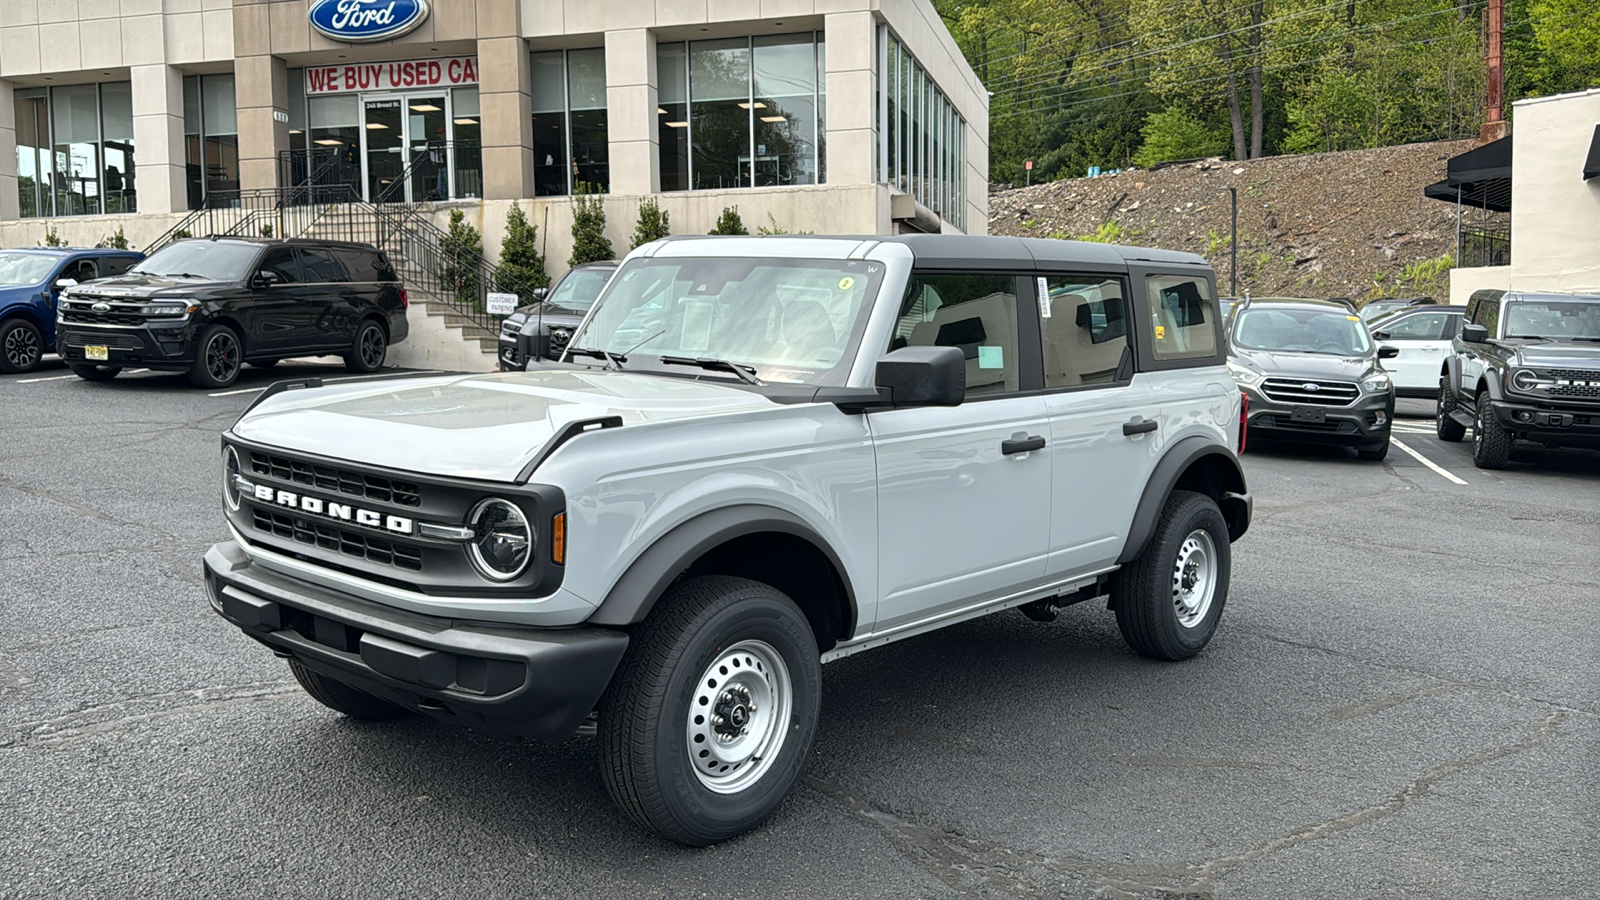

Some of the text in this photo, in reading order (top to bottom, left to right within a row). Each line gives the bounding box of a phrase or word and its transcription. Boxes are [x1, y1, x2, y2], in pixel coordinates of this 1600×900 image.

[332, 0, 395, 29] Ford
[308, 58, 479, 92] WE BUY USED CA
[842, 280, 849, 288] 2
[489, 296, 516, 304] CUSTOMER
[491, 304, 513, 312] PARKING
[255, 484, 412, 533] BRONCO
